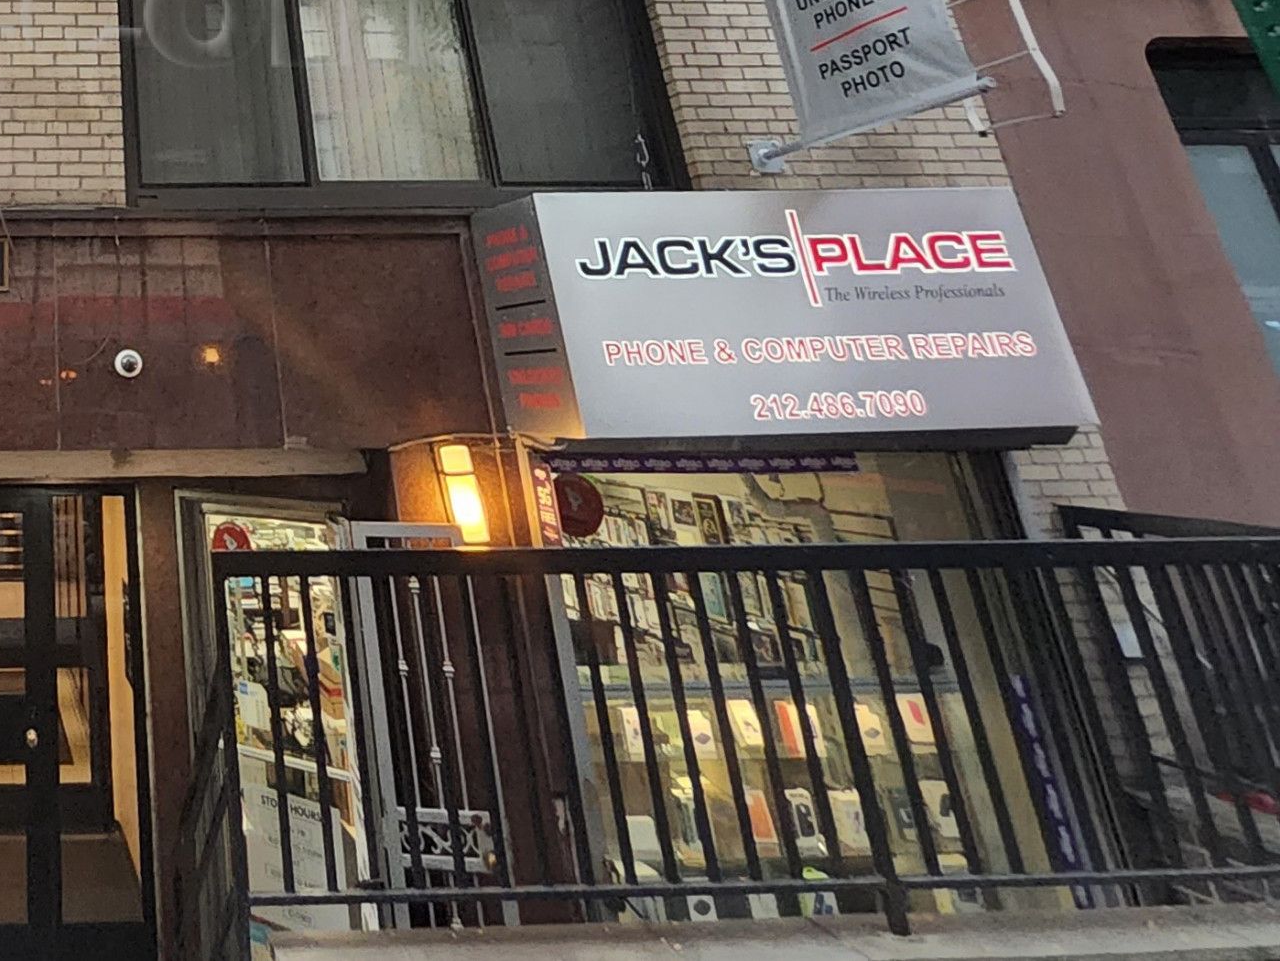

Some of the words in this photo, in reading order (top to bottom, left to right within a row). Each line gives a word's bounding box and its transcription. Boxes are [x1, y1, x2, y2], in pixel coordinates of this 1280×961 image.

[817, 26, 911, 79] PASSPORT
[840, 60, 905, 98] PHOTO
[575, 235, 798, 279] JACK'S
[804, 231, 1016, 275] PLACE
[825, 287, 849, 302] The
[854, 285, 911, 300] Wireless
[915, 283, 1006, 302] Professionals
[602, 339, 709, 366] PHONE
[714, 338, 737, 364] &
[741, 333, 909, 363] COMPUTER
[907, 330, 1037, 360] REPAIRS
[750, 390, 927, 421] 212.486.7090
